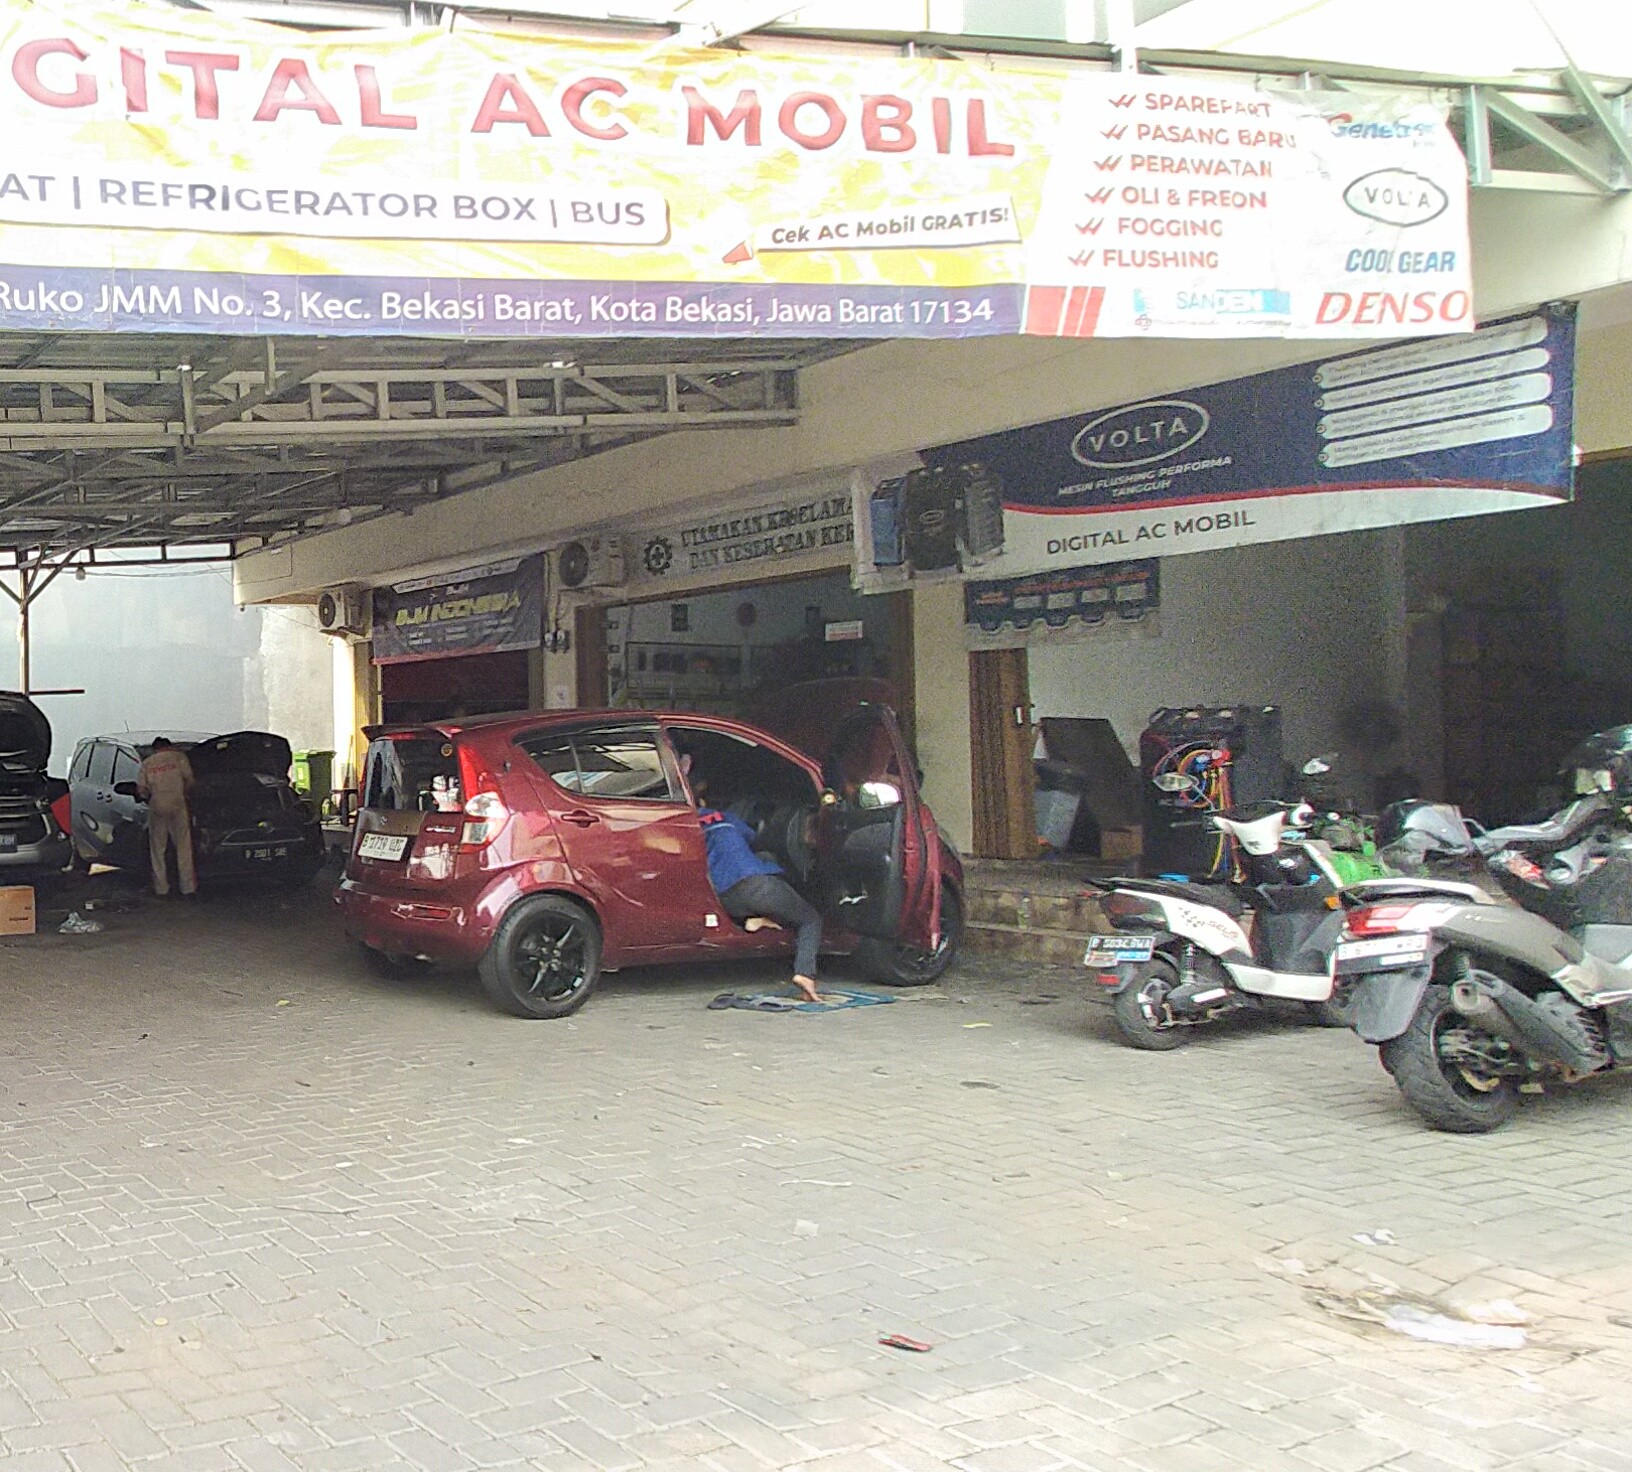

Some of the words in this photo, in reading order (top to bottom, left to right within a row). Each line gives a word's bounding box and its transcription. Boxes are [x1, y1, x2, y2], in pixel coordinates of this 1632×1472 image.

[471, 72, 630, 140] AC
[680, 85, 1015, 158] MOBIL
[1137, 123, 1229, 145] PASANG
[1238, 129, 1296, 149] BARU
[1130, 154, 1272, 177] PERAWATAN
[99, 178, 439, 219] REFRIGERATOR
[453, 197, 537, 221] BOX
[571, 201, 646, 226] BUS
[1122, 186, 1159, 204] OLI
[1167, 189, 1181, 205] &
[1189, 190, 1267, 208] FREON
[1364, 186, 1430, 208] VOLA
[772, 225, 810, 244] Cek
[818, 223, 849, 240] AC
[857, 215, 915, 237] Mobil
[922, 207, 1009, 231] GRATIS!
[1118, 217, 1222, 237] FOGGING
[1104, 249, 1218, 268] FLUSHING
[1398, 251, 1456, 273] GEAR
[93, 285, 182, 314] JMM
[194, 287, 254, 316] No.
[262, 290, 291, 321] 3,
[301, 291, 371, 320] Kec.
[381, 292, 485, 321] Bekasi
[494, 294, 582, 325] Barat,
[591, 295, 656, 322] Kota
[665, 296, 760, 326] Bekasi,
[766, 298, 831, 324] Jawa
[839, 298, 903, 324] Barat
[910, 299, 994, 324] 17134
[1315, 290, 1469, 325] DENSO
[1090, 417, 1188, 452] VOLTA
[1097, 471, 1156, 489] FLUSHING
[1047, 530, 1129, 555] DIGITAL
[1135, 523, 1167, 542] AC
[1173, 510, 1257, 537] MOBIL
